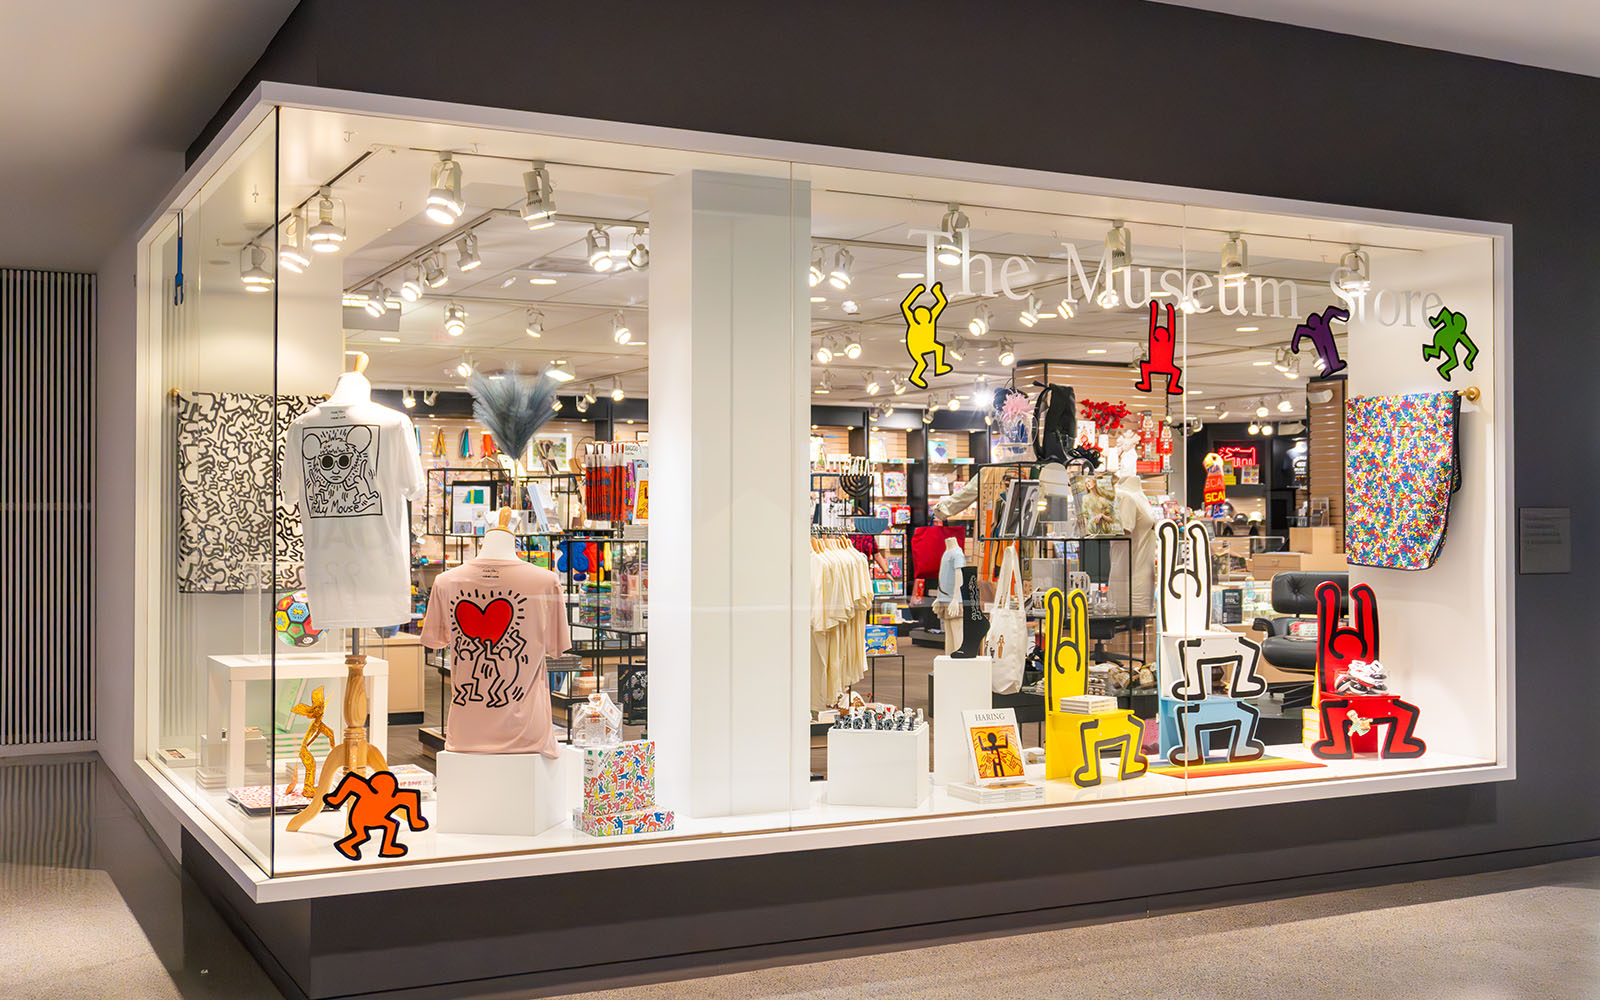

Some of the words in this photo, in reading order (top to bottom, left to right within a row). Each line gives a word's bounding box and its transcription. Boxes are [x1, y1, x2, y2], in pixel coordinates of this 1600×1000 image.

[907, 226, 1033, 301] The
[1061, 242, 1302, 319] Museum
[1330, 266, 1443, 329] Store
[331, 500, 375, 514] Mouse
[975, 713, 1005, 721] HARING
